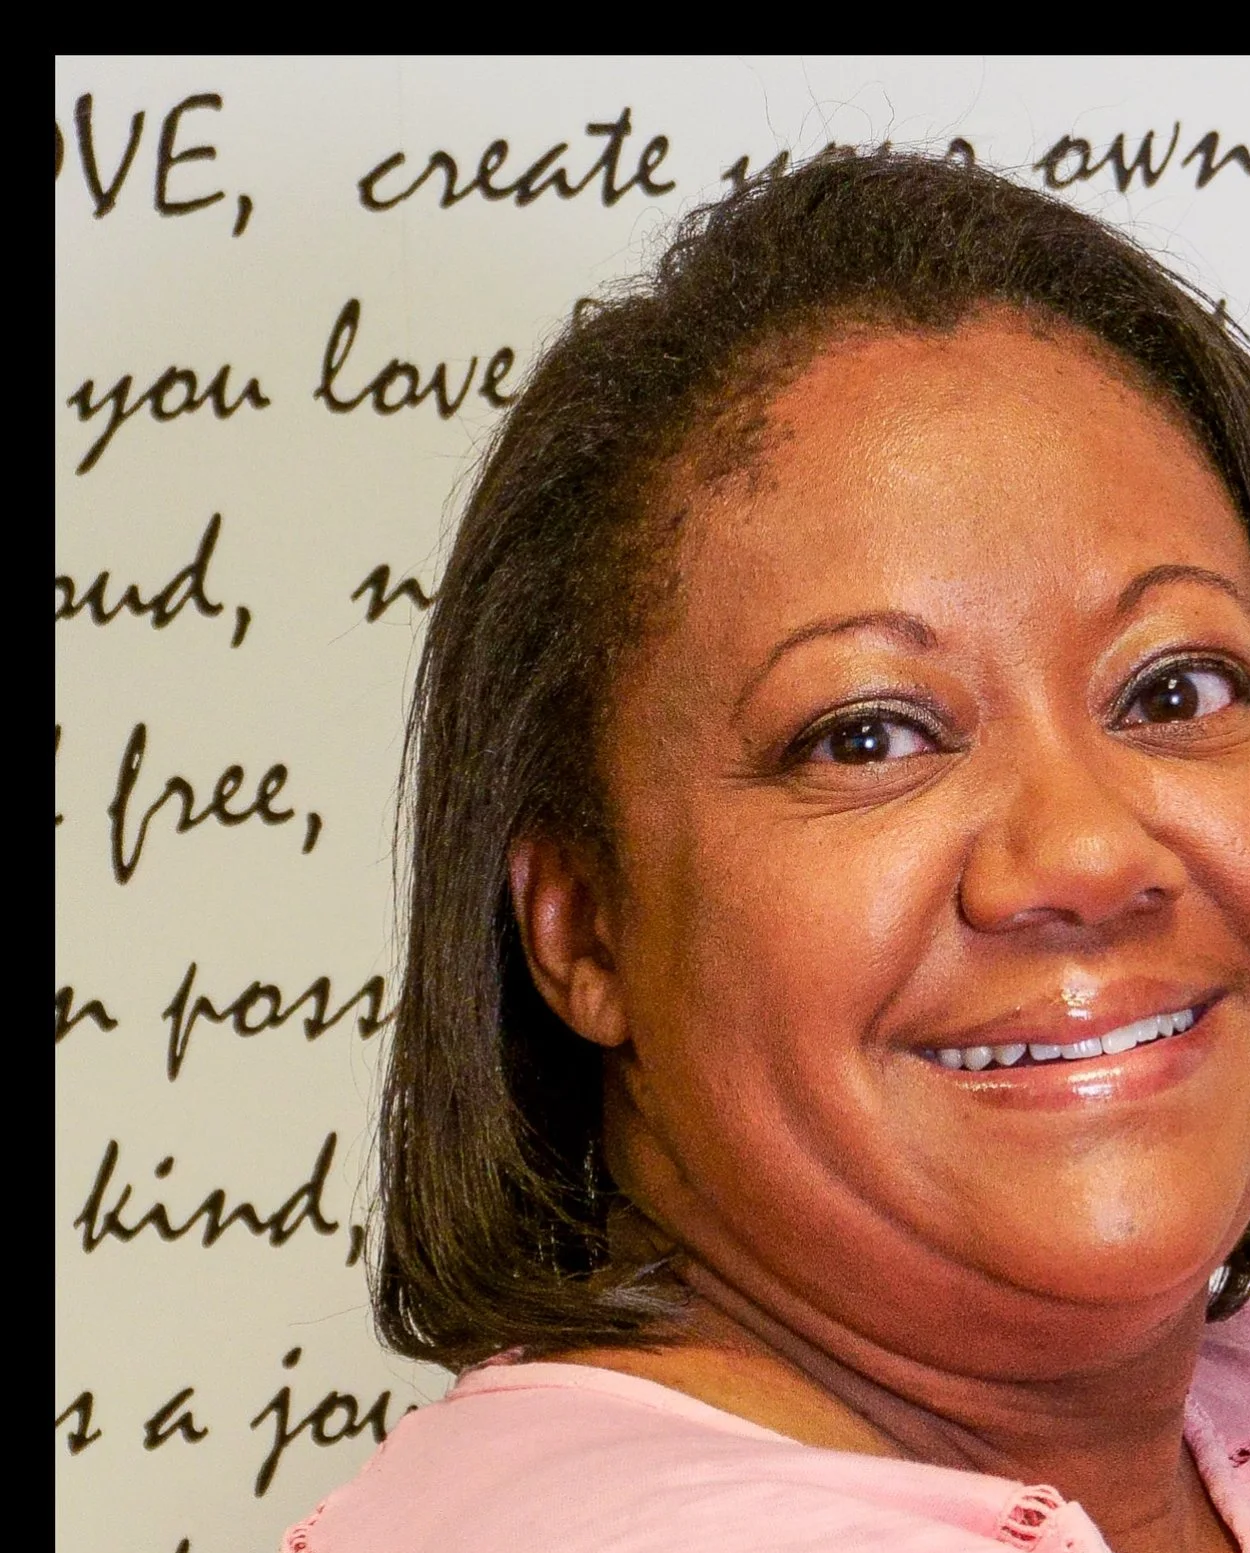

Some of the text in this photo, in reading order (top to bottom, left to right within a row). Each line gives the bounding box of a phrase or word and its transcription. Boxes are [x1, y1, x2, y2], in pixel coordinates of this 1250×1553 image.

[55, 91, 254, 238] VE,
[357, 106, 677, 210] create
[66, 363, 272, 477] you
[312, 297, 518, 421] love
[106, 721, 324, 887] free,
[161, 960, 394, 1082] poss
[72, 1130, 365, 1268] kind,
[142, 1386, 210, 1451] a
